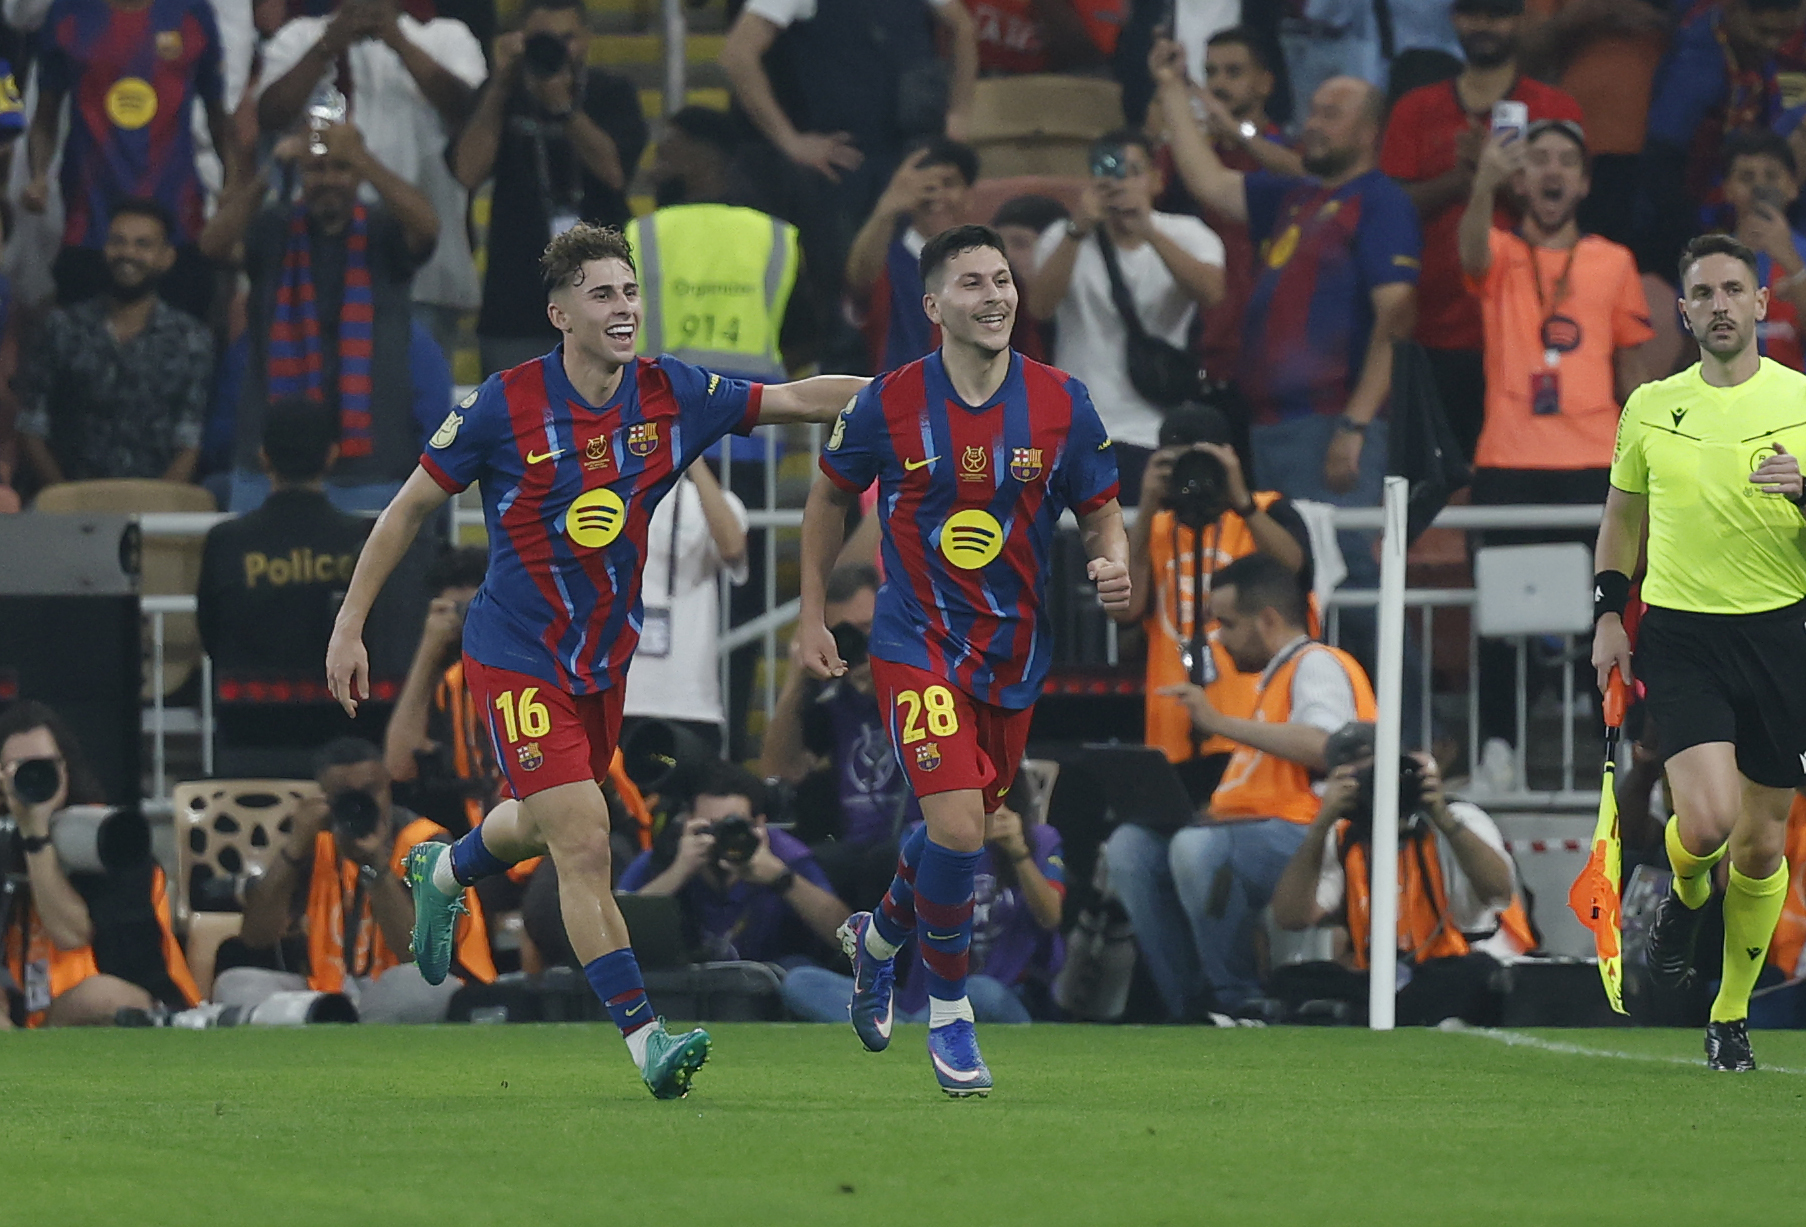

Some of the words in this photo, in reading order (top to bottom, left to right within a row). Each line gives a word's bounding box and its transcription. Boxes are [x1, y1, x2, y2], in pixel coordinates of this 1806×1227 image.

[680, 314, 740, 346] 914
[495, 687, 551, 744] 16
[897, 685, 959, 744] 28
